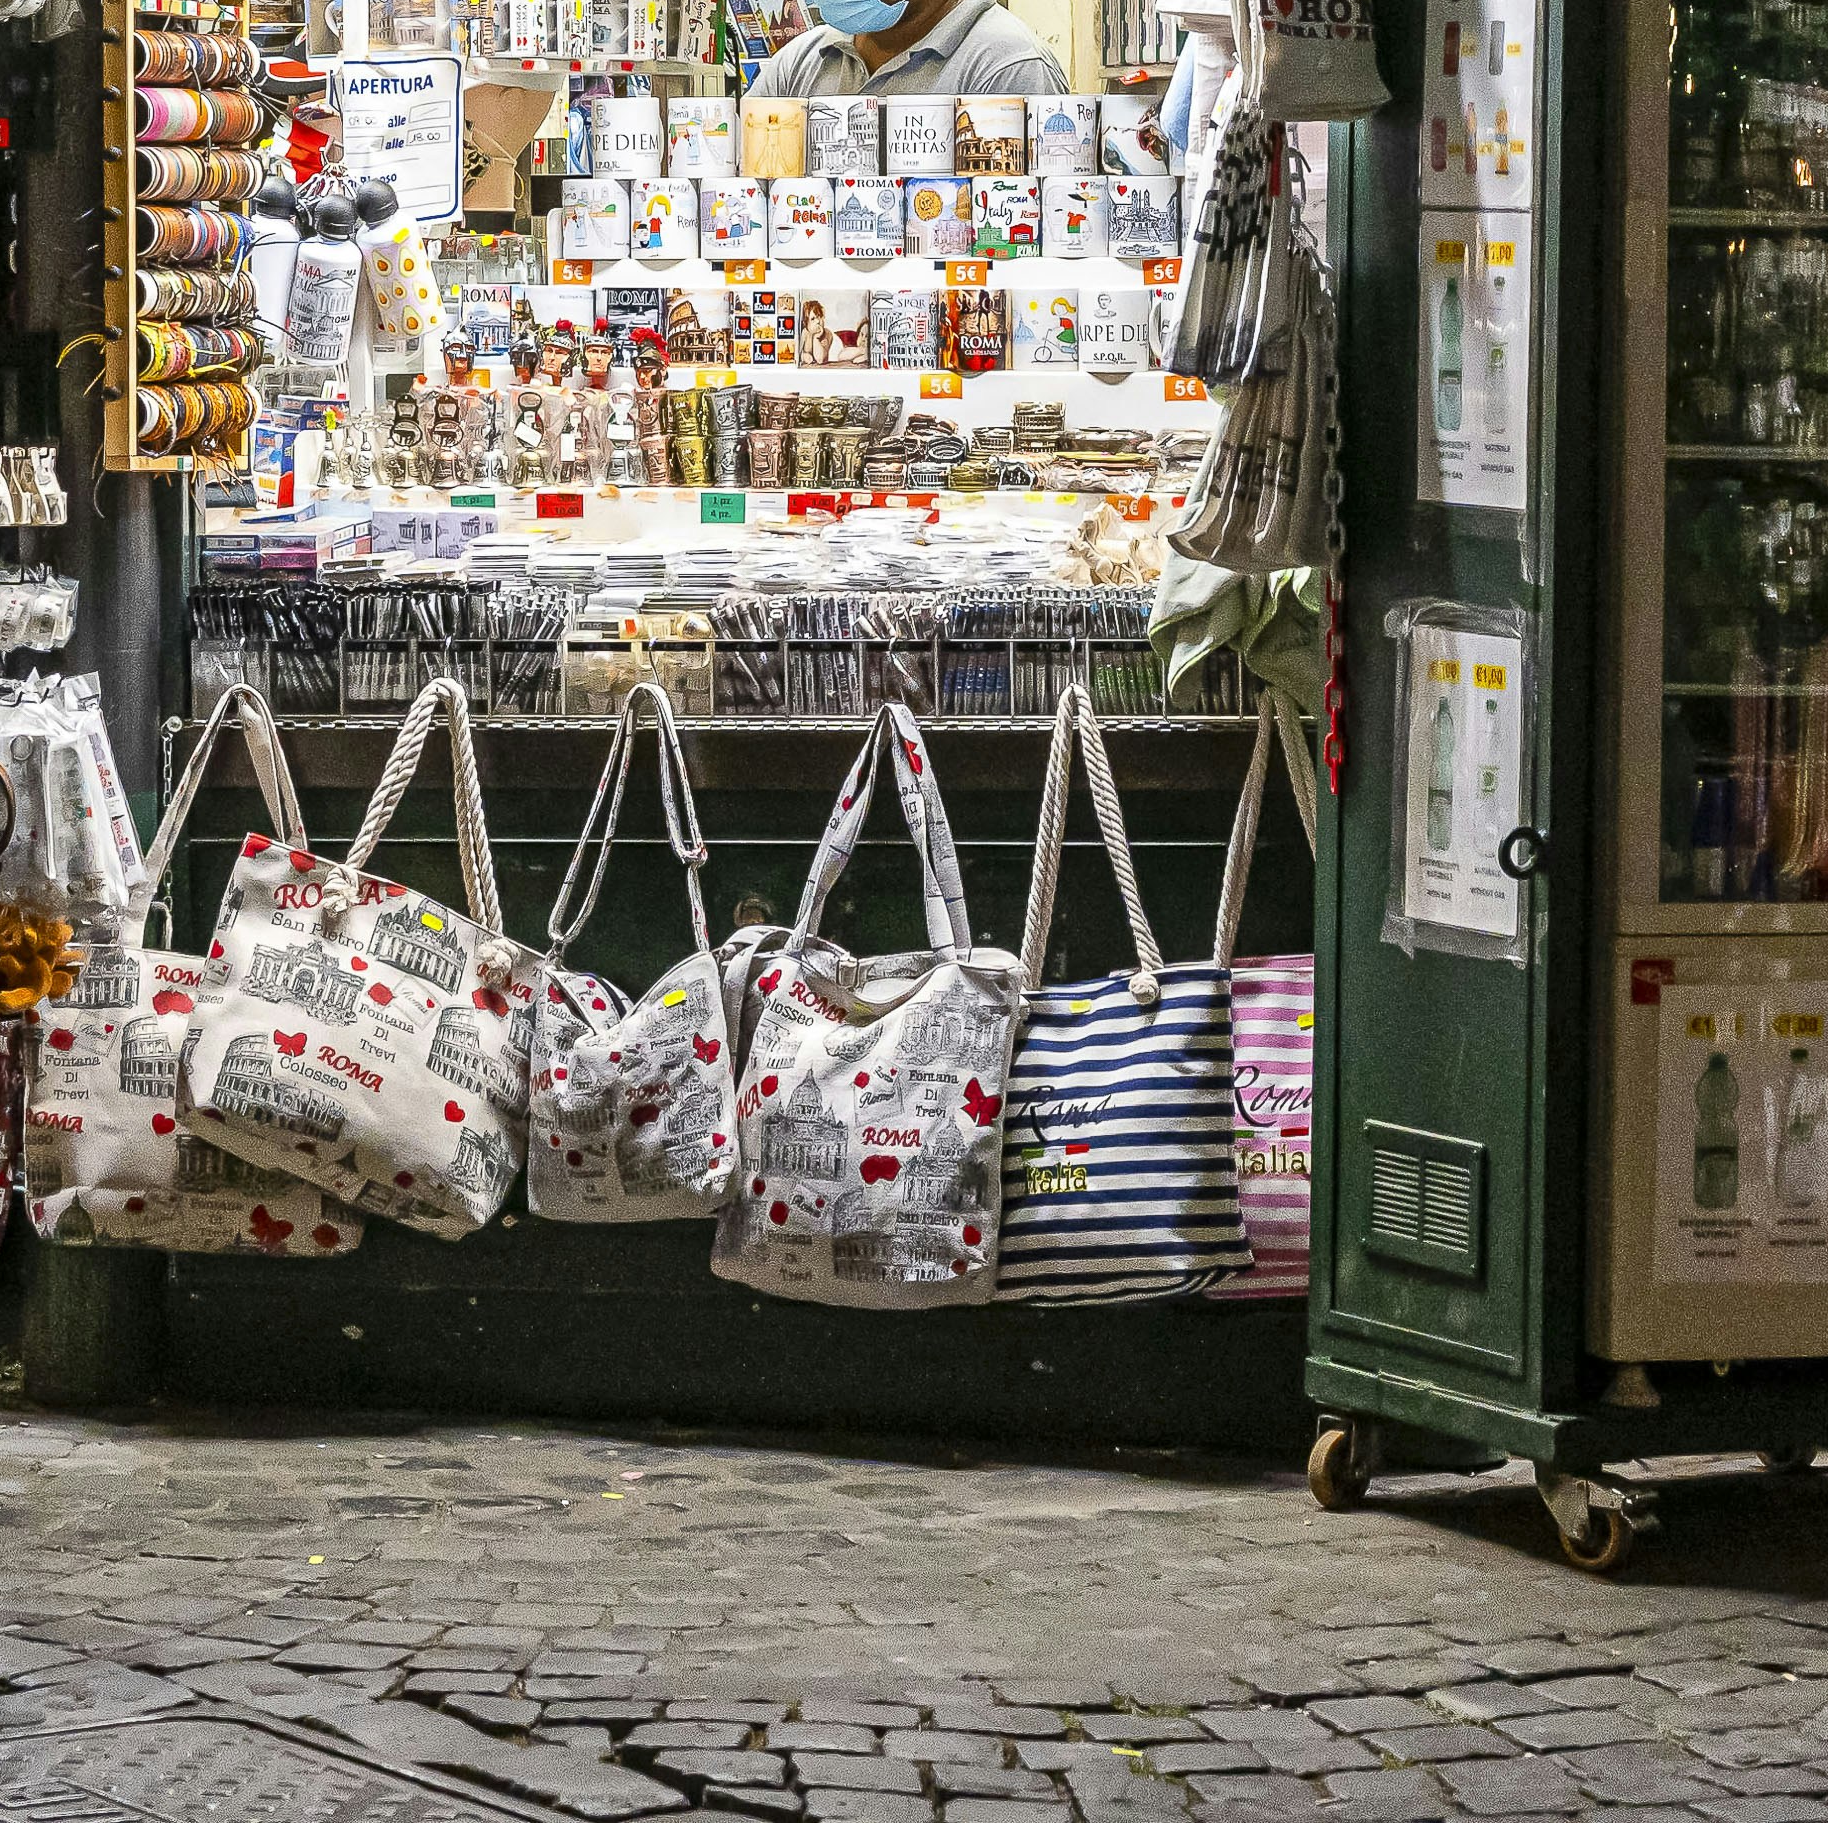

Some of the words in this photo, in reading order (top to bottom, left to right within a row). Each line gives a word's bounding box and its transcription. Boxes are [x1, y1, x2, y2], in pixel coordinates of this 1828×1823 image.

[349, 75, 433, 94] APERTURA
[388, 116, 406, 127] alle
[905, 115, 923, 126] IN
[616, 133, 659, 151] DIEM
[893, 128, 937, 141] VINO
[386, 138, 404, 149] alle
[888, 141, 947, 154] VERITAS
[975, 190, 1013, 225] Italy
[563, 264, 585, 281] 5€
[734, 263, 756, 281] 5€
[956, 264, 978, 281] 5€
[1153, 263, 1175, 280] 5€
[463, 287, 510, 304] ROMA
[609, 289, 658, 306] ROMA
[960, 334, 1003, 349] ROMA
[930, 378, 952, 394] 5€
[1173, 379, 1198, 397] 5€
[1117, 497, 1139, 517] 5€
[275, 882, 383, 910] ROA
[271, 912, 305, 931] San
[309, 921, 364, 953] Pietro
[789, 981, 847, 1024] ROMA
[358, 1003, 415, 1035] Fontana
[45, 1053, 101, 1067] Fontana
[360, 1039, 396, 1064] Trevi
[279, 1054, 348, 1093] Colosseo
[317, 1045, 383, 1094] ROMA
[908, 1070, 960, 1086] Fontana
[54, 1088, 90, 1101] Trevi
[915, 1104, 946, 1119] Trevi
[862, 1127, 922, 1148] ROMA
[1024, 1164, 1088, 1194] Italia
